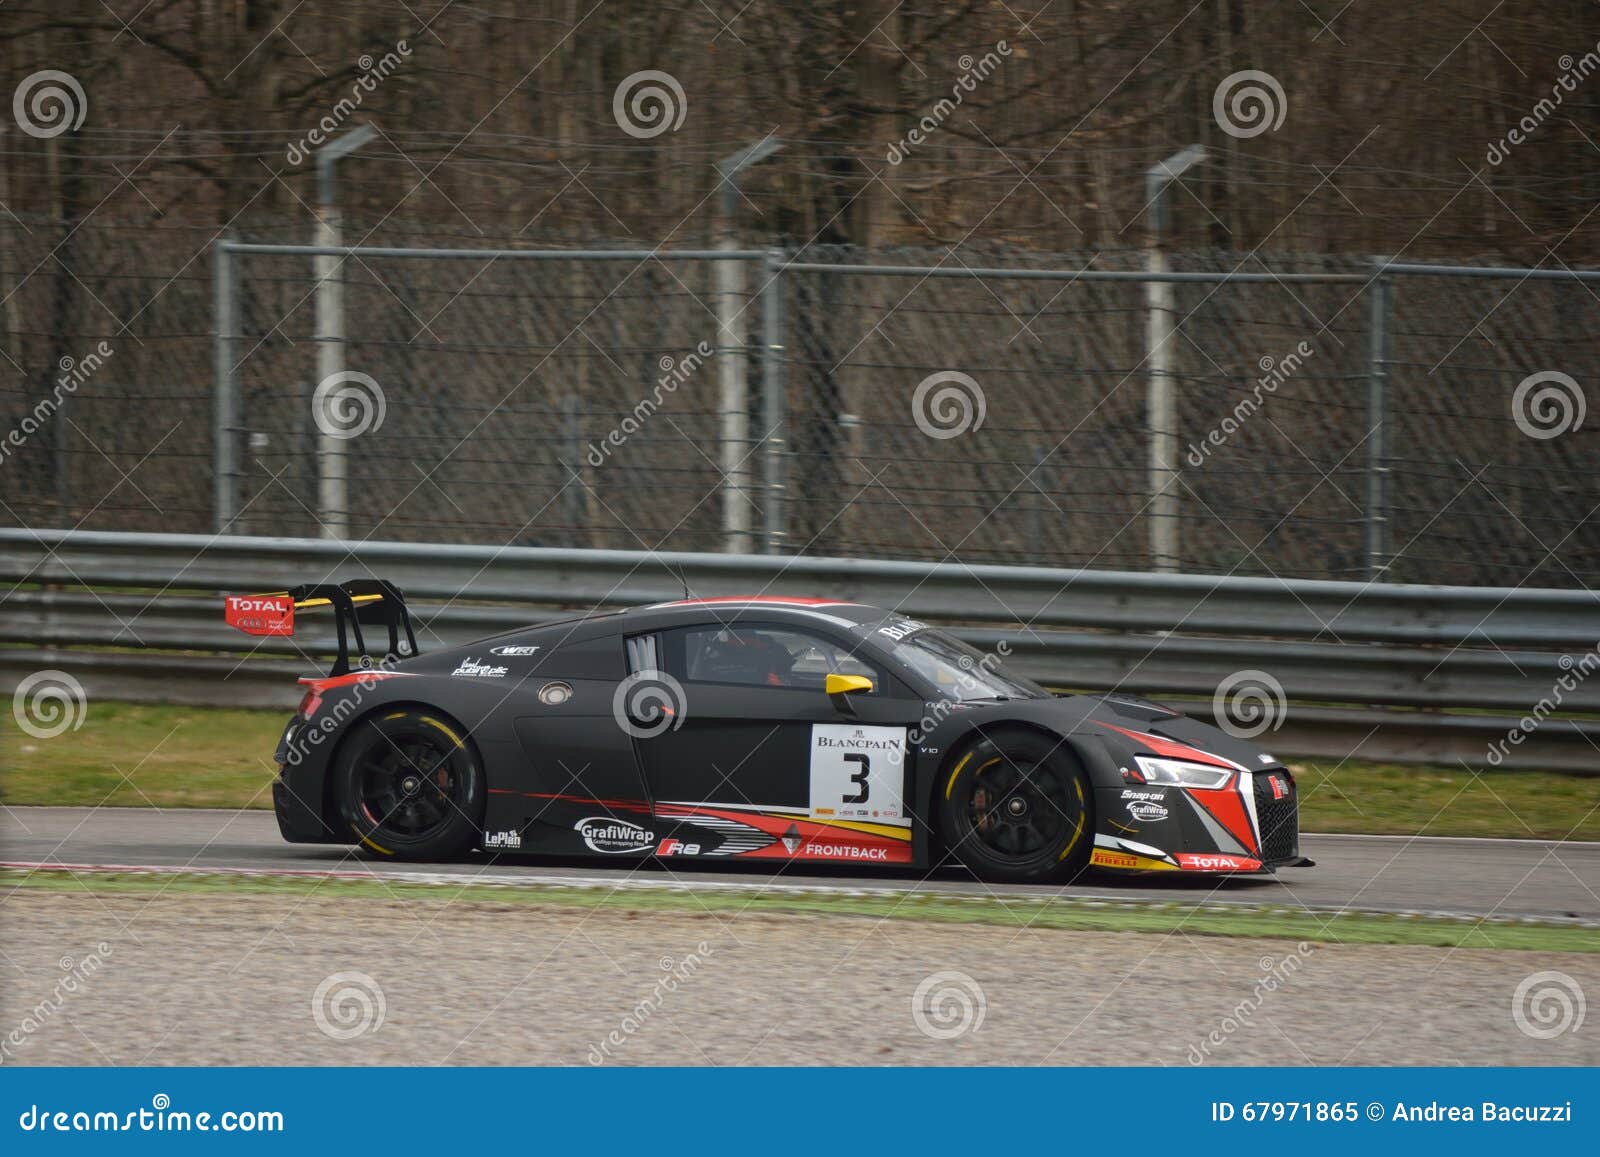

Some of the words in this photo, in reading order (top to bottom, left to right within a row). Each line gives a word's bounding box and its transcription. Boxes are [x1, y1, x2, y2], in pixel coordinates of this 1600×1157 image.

[229, 597, 287, 611] TOTAL
[818, 736, 900, 750] BLANCPAIN
[842, 753, 870, 804] 3
[1120, 790, 1164, 800] Snap-on
[581, 825, 655, 844] GrafiWrap
[667, 842, 701, 855] R8
[805, 844, 888, 860] FRONTBACK
[1187, 856, 1240, 868] TOTAL
